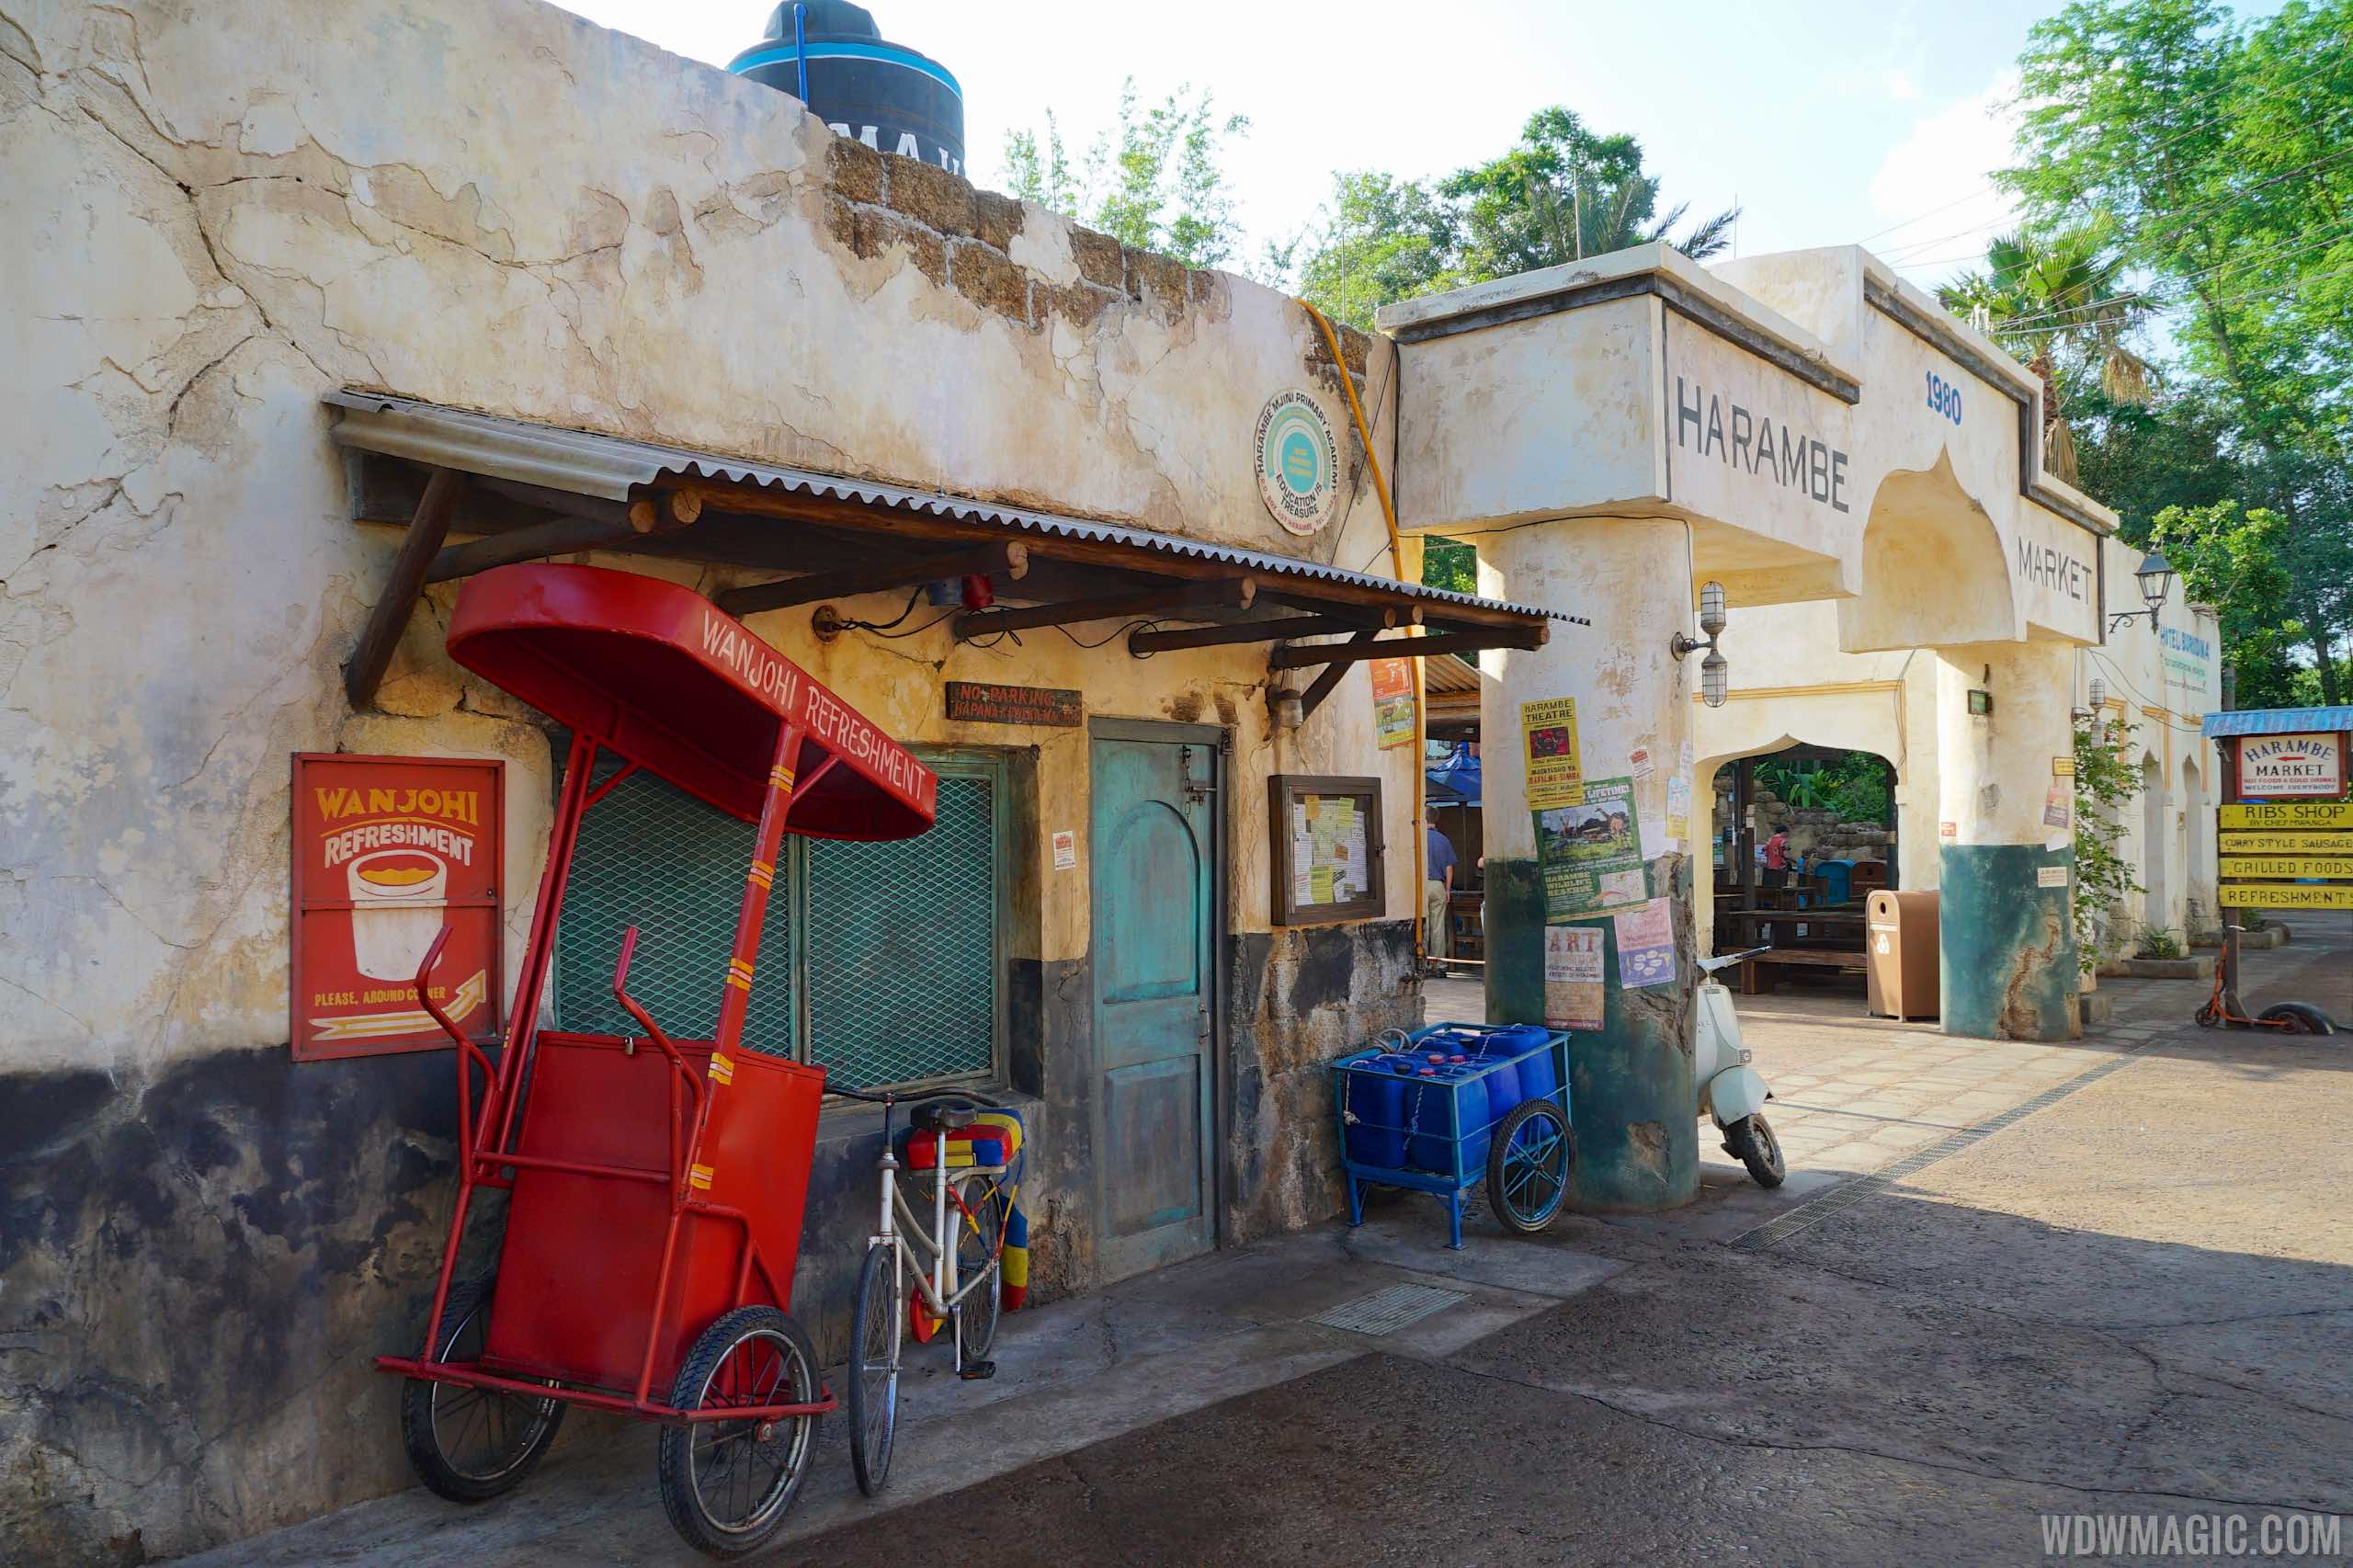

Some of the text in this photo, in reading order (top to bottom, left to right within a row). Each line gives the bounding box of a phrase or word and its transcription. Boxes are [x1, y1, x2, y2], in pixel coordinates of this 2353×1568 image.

[1926, 369, 1962, 426] 1980
[1256, 408, 1274, 473] HARAMBE
[1273, 392, 1294, 413] MJINI
[1296, 392, 1328, 426] PRIMARY
[1325, 430, 1338, 489] ACADEMY
[1677, 375, 1849, 514] HARAMBE
[1276, 473, 1316, 507] EDUCATION
[1316, 482, 1323, 495] IS
[1280, 495, 1319, 519] TREASURE
[2018, 537, 2092, 606] MARKET
[960, 684, 981, 699] NO
[703, 610, 926, 801] WANJOHI REFRESHMENT
[954, 702, 998, 720] HAPANA
[1525, 700, 1571, 713] HARAMBE
[1526, 709, 1573, 723] THEATRE
[2245, 739, 2336, 763] HARAMBE
[2256, 764, 2325, 777] MARKET
[314, 788, 478, 825] WANJOHI
[2245, 805, 2346, 819] RIBS SHOP
[324, 824, 474, 868] REFRESHMENT
[2225, 838, 2353, 848] CURRY STYLE SAUSAGE
[1545, 871, 1591, 883] HARAMBE
[2234, 862, 2353, 874] GRILLED FOODS
[1547, 885, 1594, 898] RESERVE
[1549, 931, 1597, 953] ART
[363, 988, 406, 1005] AROUND
[406, 986, 447, 1003] CONER
